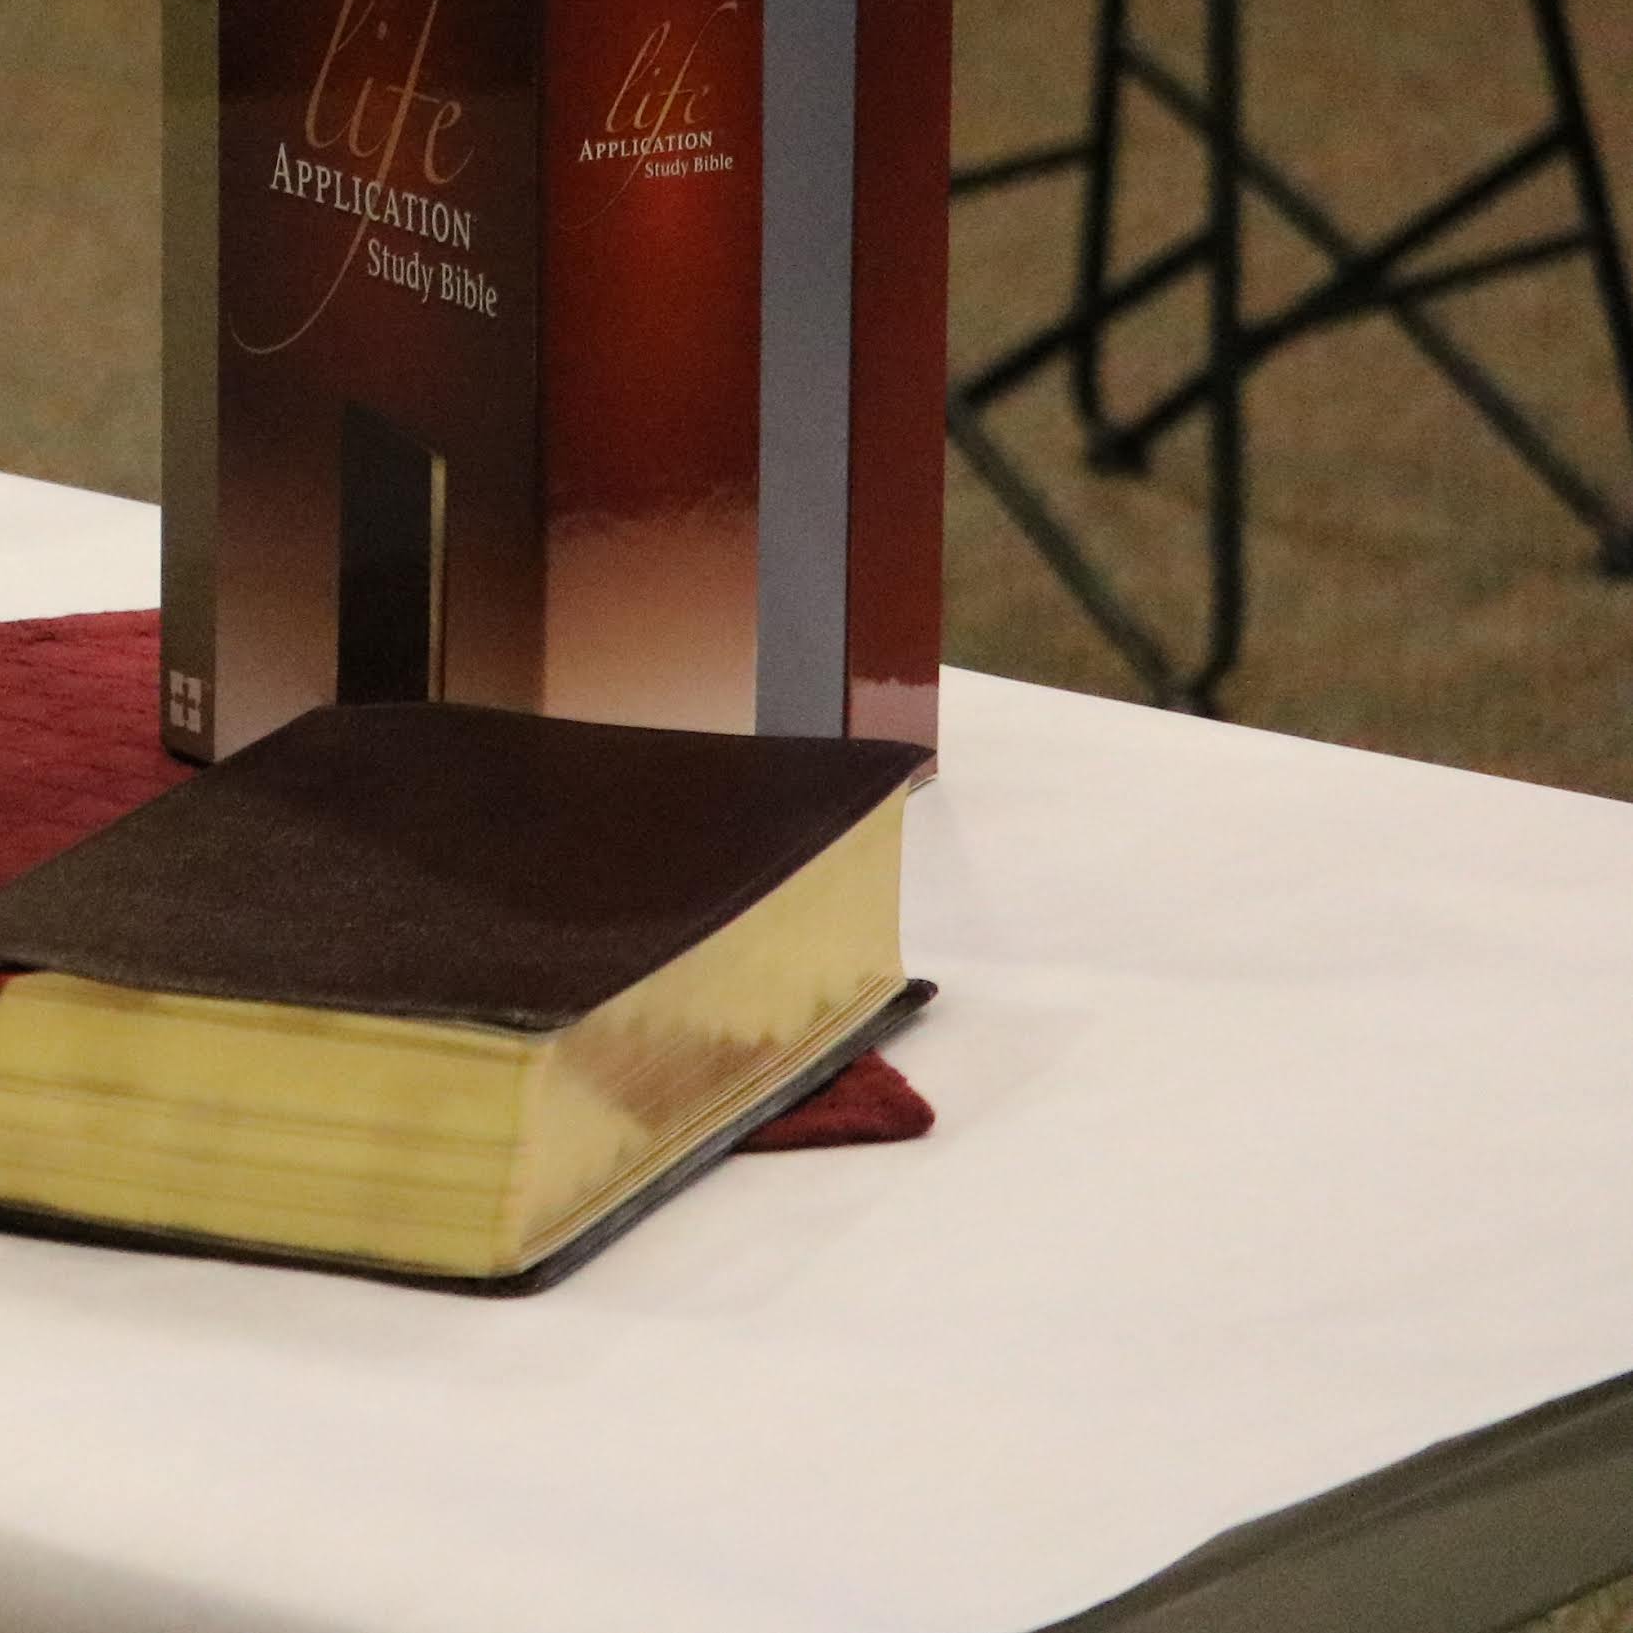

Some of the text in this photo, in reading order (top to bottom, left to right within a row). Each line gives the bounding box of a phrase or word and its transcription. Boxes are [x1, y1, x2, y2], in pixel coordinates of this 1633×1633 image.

[578, 131, 714, 163] APPLICATION
[644, 144, 734, 179] Study Bible
[270, 142, 473, 252] APPLICATION
[367, 239, 498, 318] Study Bible
